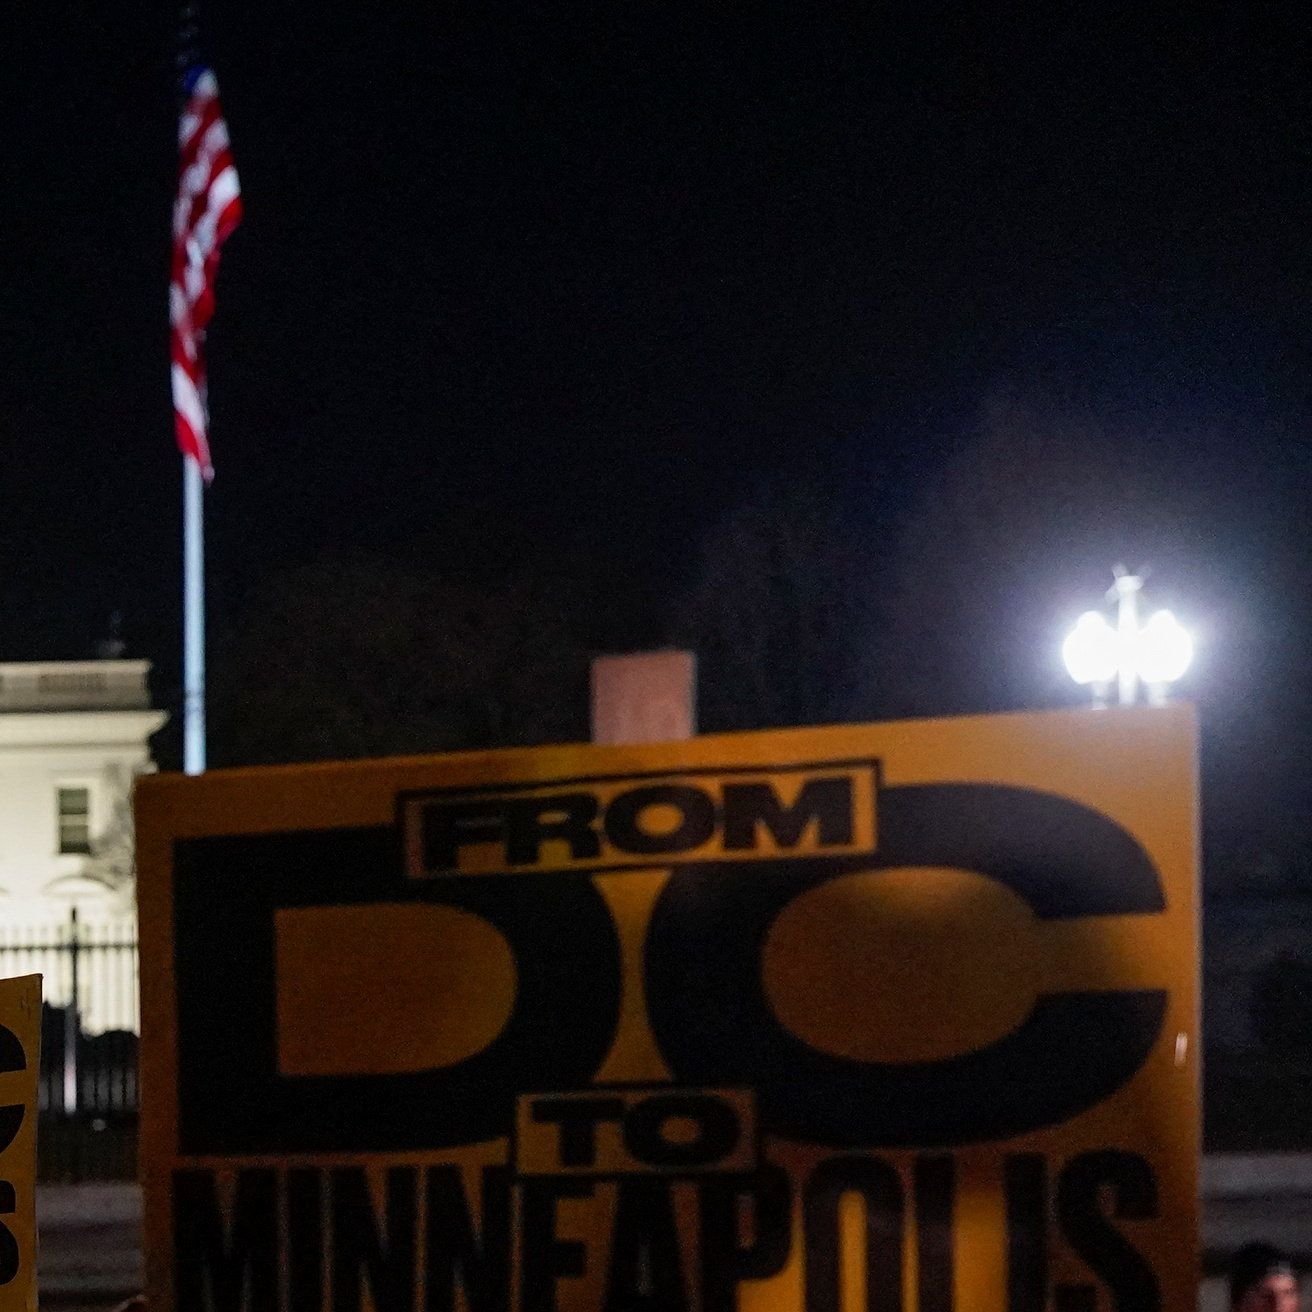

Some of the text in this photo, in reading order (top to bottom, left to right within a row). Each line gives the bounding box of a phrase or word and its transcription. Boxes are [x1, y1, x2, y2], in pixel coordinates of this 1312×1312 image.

[424, 777, 855, 867] FROM
[174, 781, 1166, 1151] DC
[532, 1092, 740, 1168] TO
